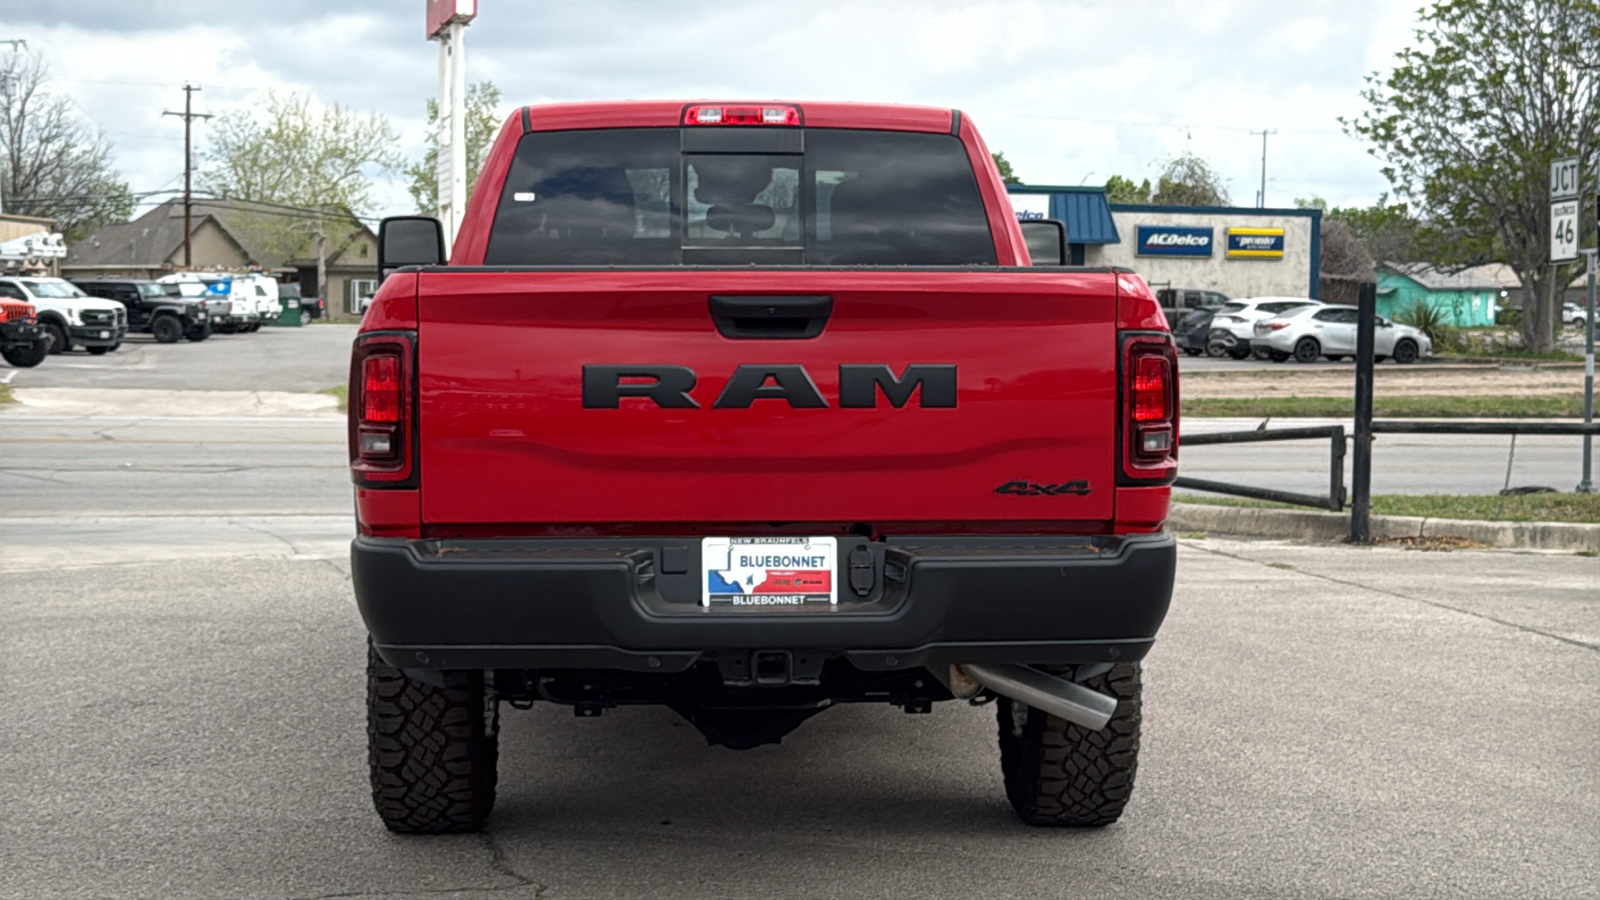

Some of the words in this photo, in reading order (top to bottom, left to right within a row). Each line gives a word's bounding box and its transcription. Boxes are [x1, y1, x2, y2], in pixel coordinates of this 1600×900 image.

[1552, 165, 1576, 192] JCT
[1015, 209, 1044, 220] elco
[1555, 219, 1574, 245] 46
[1146, 233, 1209, 246] ACDelco
[582, 363, 958, 409] RAM
[740, 555, 825, 567] BLUEBONNET
[732, 595, 806, 605] BLUEBONNET
